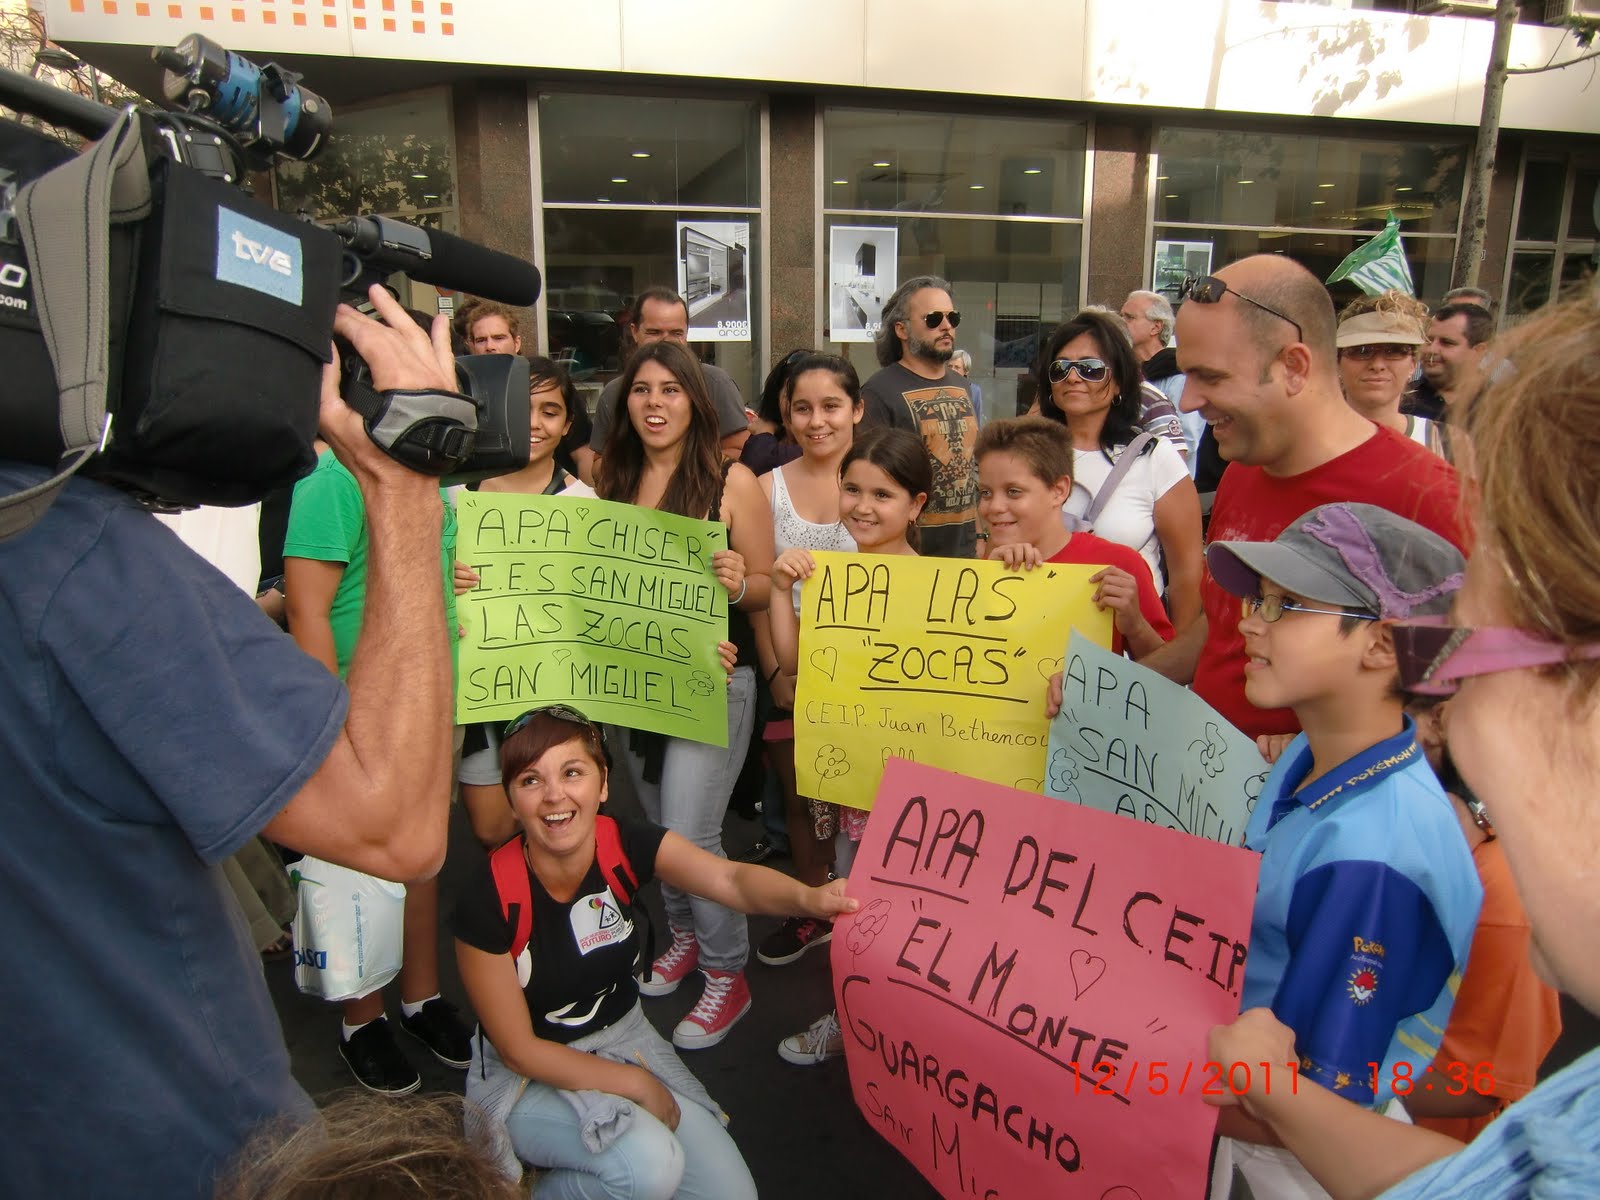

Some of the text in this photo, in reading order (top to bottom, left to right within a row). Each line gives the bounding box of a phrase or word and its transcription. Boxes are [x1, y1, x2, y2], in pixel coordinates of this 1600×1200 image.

[232, 230, 292, 276] tve
[718, 329, 748, 337] arco
[571, 565, 631, 600] SAN
[638, 572, 726, 619] MIGUEL
[816, 563, 890, 624] APA
[482, 603, 692, 660] LAS ZOCAS
[464, 661, 692, 712] SAN MIGUEL
[878, 706, 927, 736] Juan
[1002, 835, 1098, 937] DEL
[581, 933, 612, 949] FUTURO
